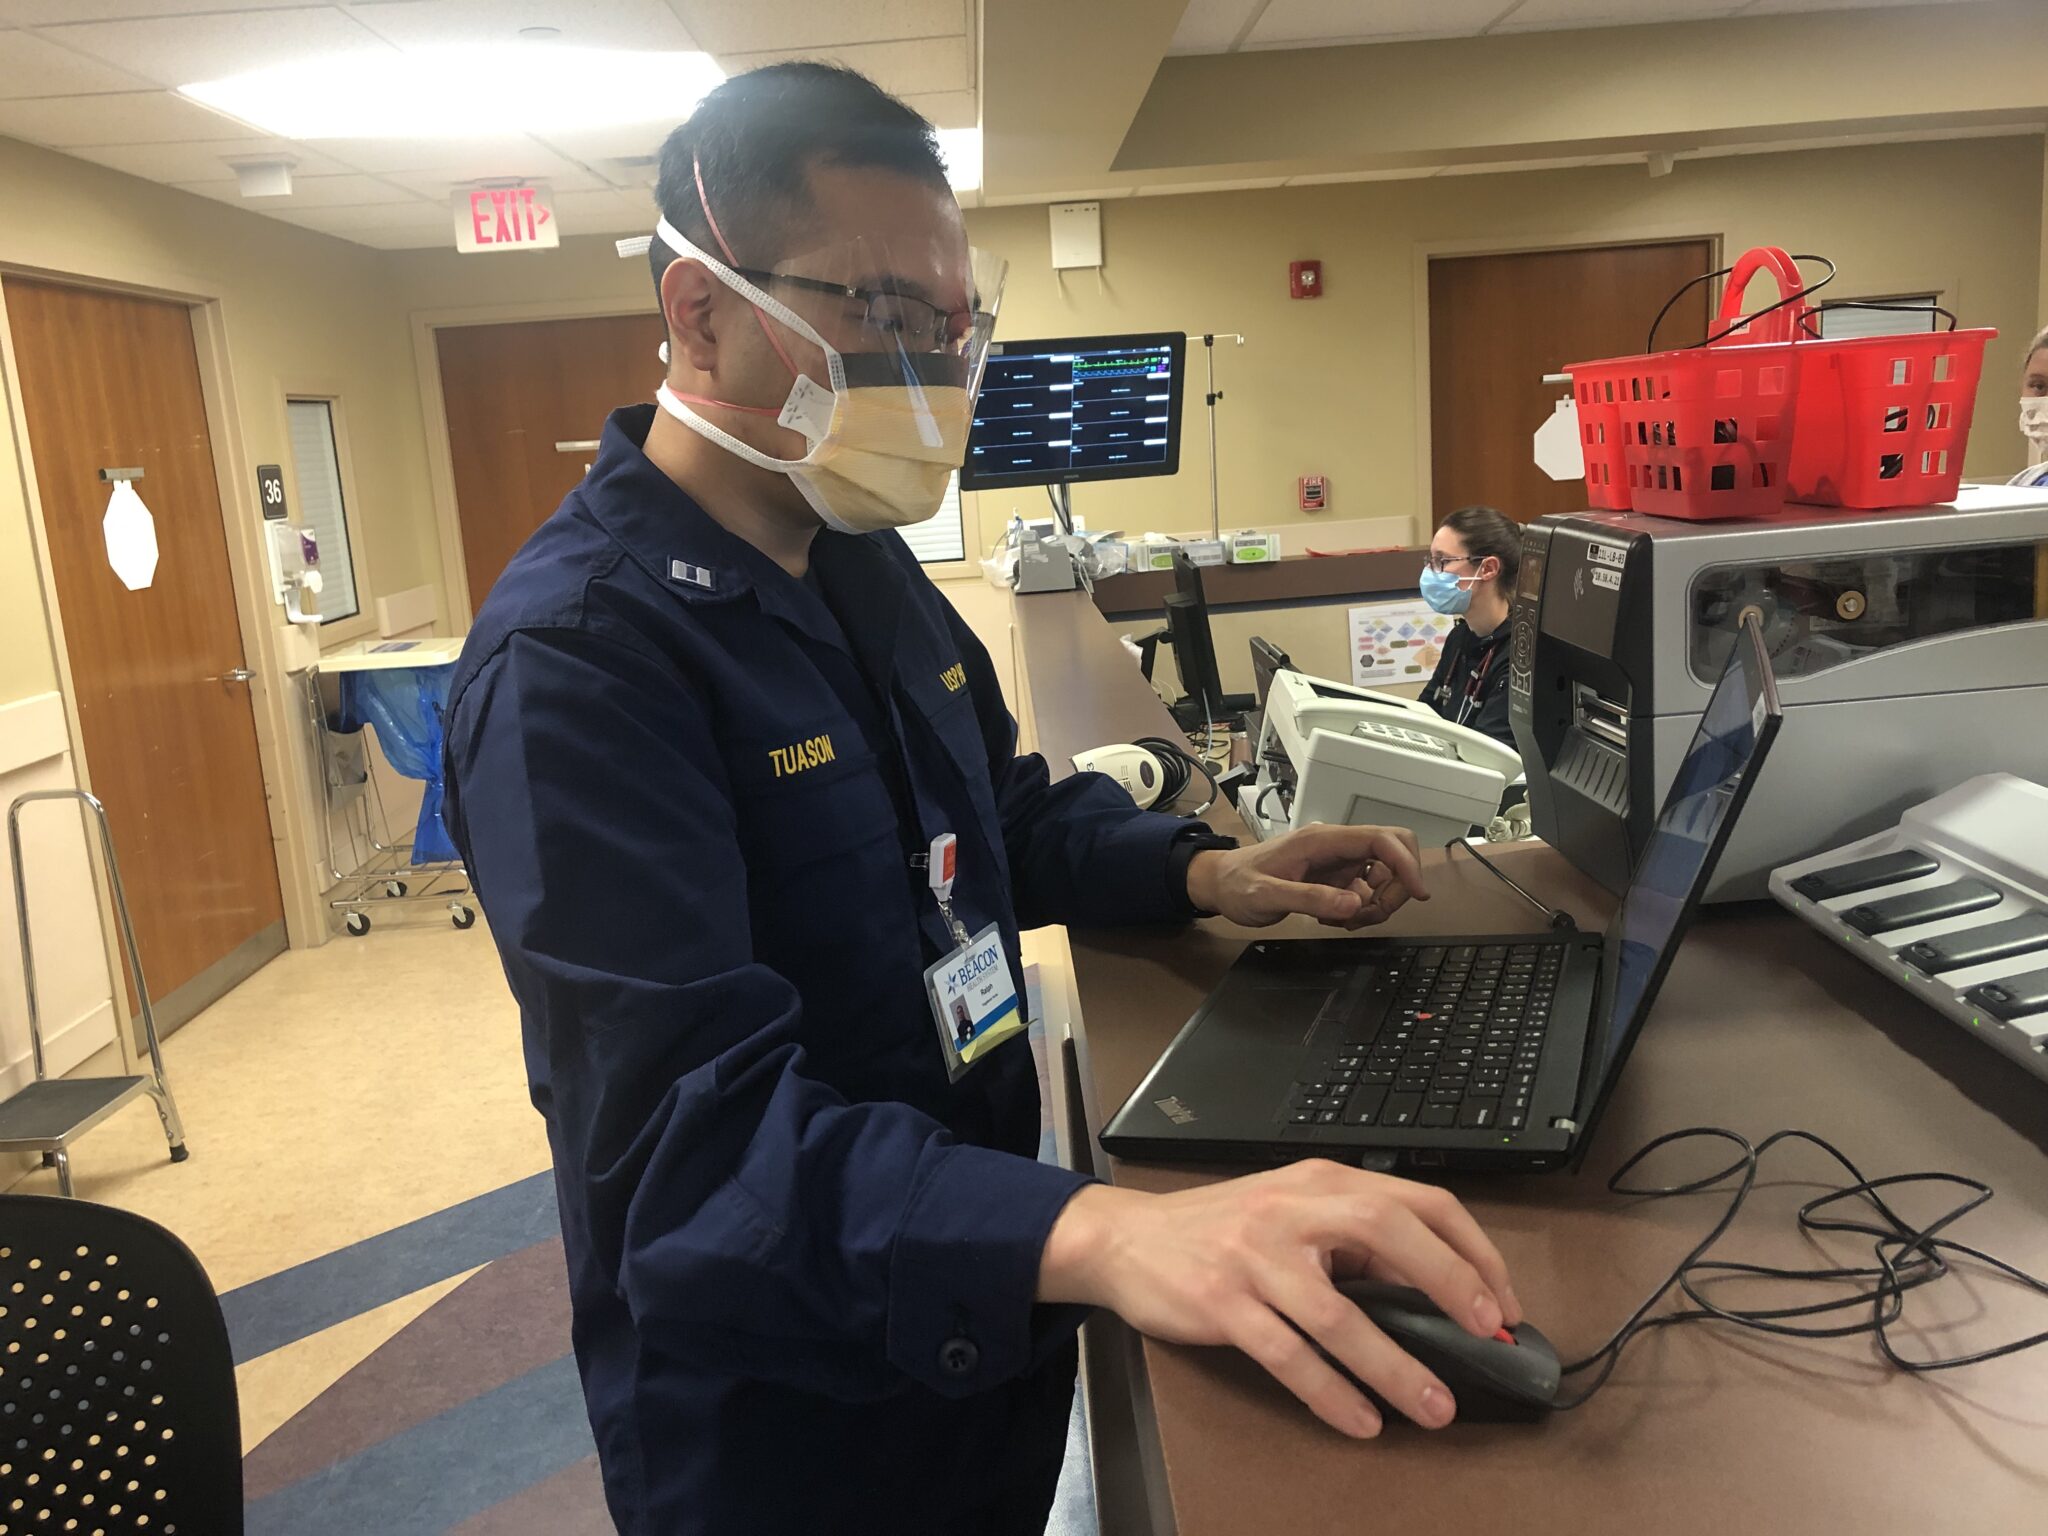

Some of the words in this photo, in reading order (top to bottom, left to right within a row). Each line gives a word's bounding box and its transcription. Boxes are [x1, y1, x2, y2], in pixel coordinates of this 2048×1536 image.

[469, 188, 537, 244] EXIT
[264, 479, 282, 504] 36
[1304, 477, 1322, 486] FIRE
[768, 734, 836, 778] TUASON
[958, 945, 998, 986] BEACON
[980, 984, 993, 994] Ralph
